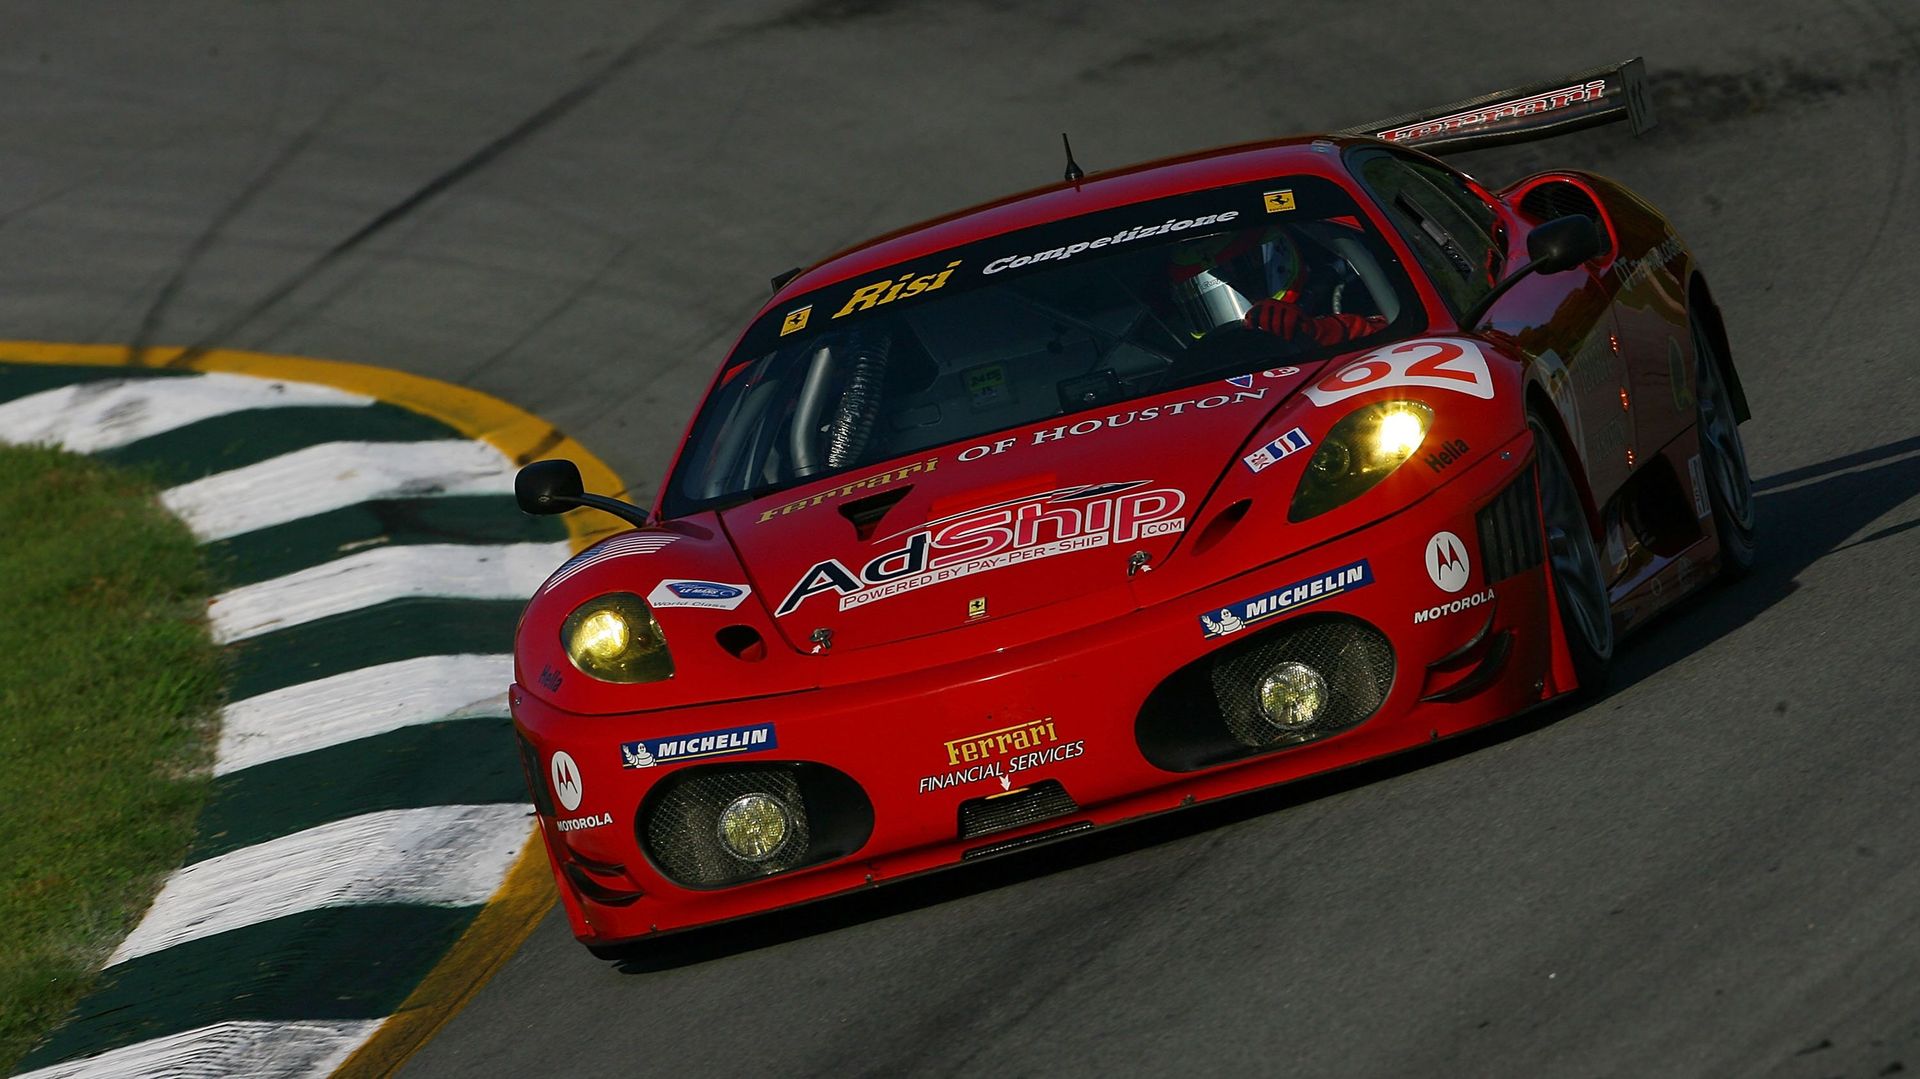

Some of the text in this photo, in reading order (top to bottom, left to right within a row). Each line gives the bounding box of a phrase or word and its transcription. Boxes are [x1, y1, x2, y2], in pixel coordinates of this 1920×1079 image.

[982, 210, 1240, 275] Competizione
[831, 260, 962, 319] Risi
[1317, 341, 1478, 391] 62
[755, 387, 1269, 524] Ferrari OF HOUSTON
[1424, 439, 1469, 473] Hella
[844, 577, 931, 608] POWERED
[937, 567, 961, 582] BY
[1246, 565, 1363, 619] MICHELIN
[1414, 588, 1495, 624] MOTOROLA
[658, 728, 768, 758] MICHELIN
[944, 717, 1058, 765] Ferrari
[919, 740, 1084, 794] FINANCIAL SERVICES
[557, 812, 613, 832] MOTOROLA
